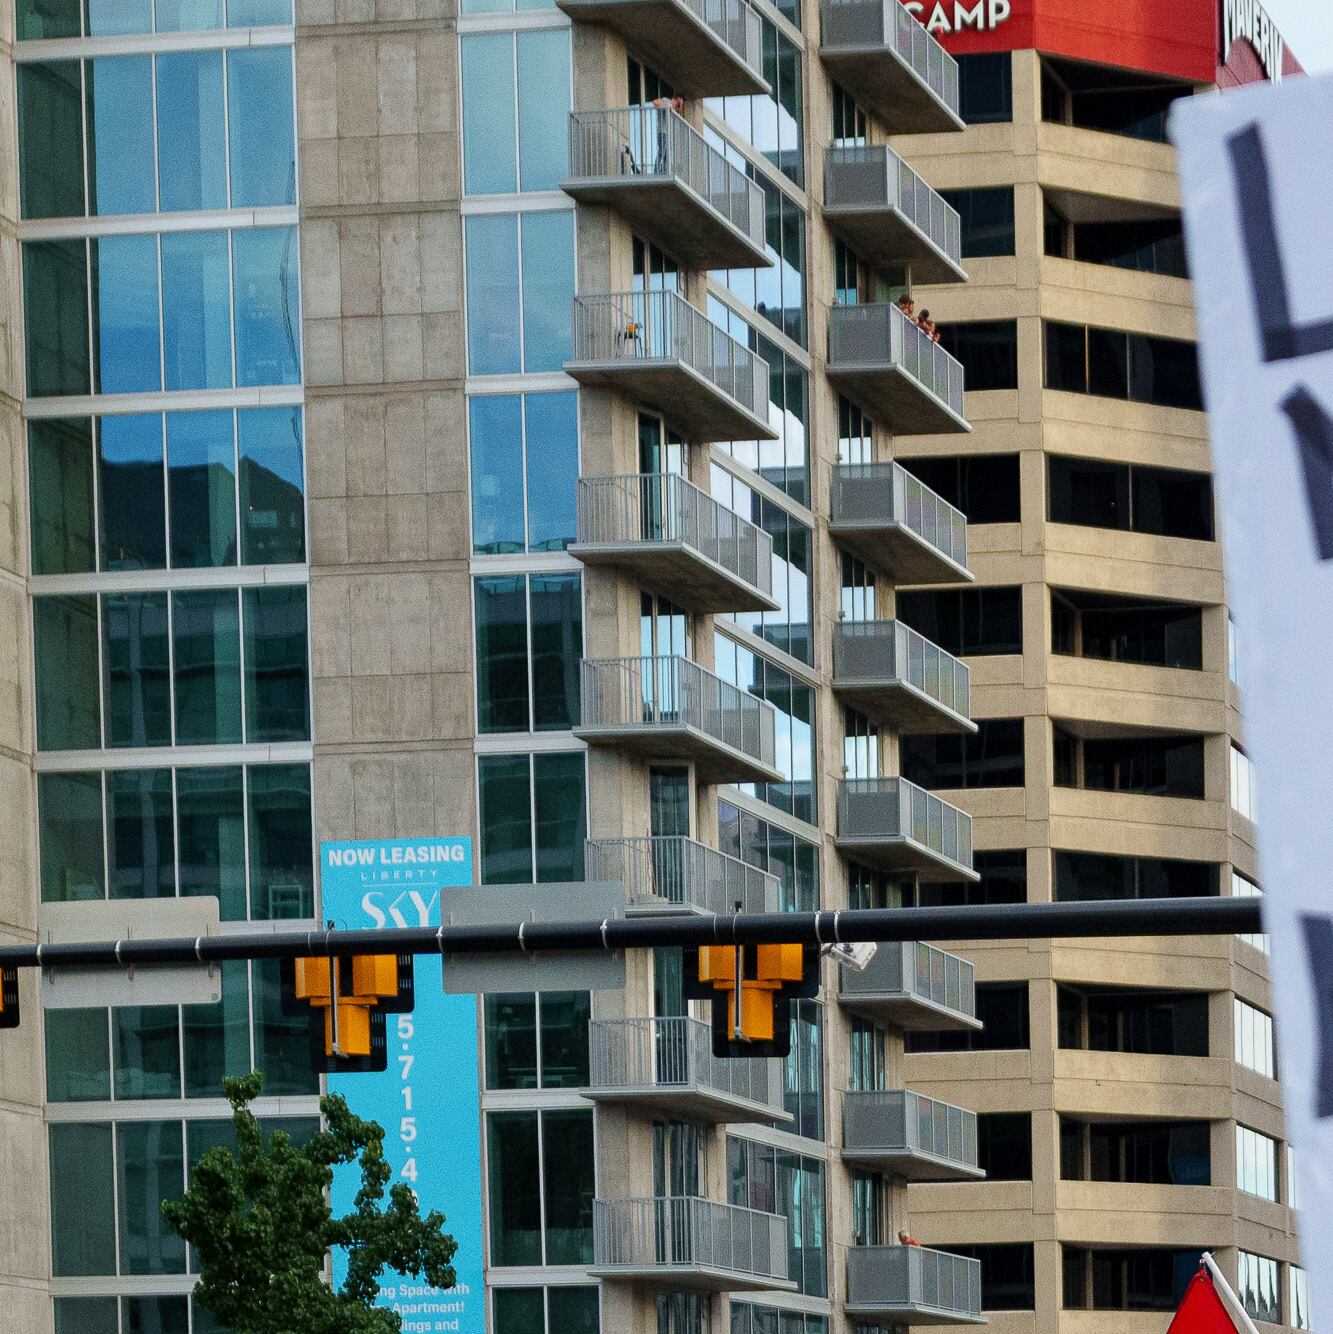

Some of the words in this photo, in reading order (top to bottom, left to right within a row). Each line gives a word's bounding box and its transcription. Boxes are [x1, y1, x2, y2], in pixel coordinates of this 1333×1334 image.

[328, 848, 375, 866] NOW
[380, 845, 465, 865] LEASING
[360, 869, 438, 881] LIBERTY
[392, 1300, 465, 1316] Apartment!
[434, 1319, 460, 1331] and
